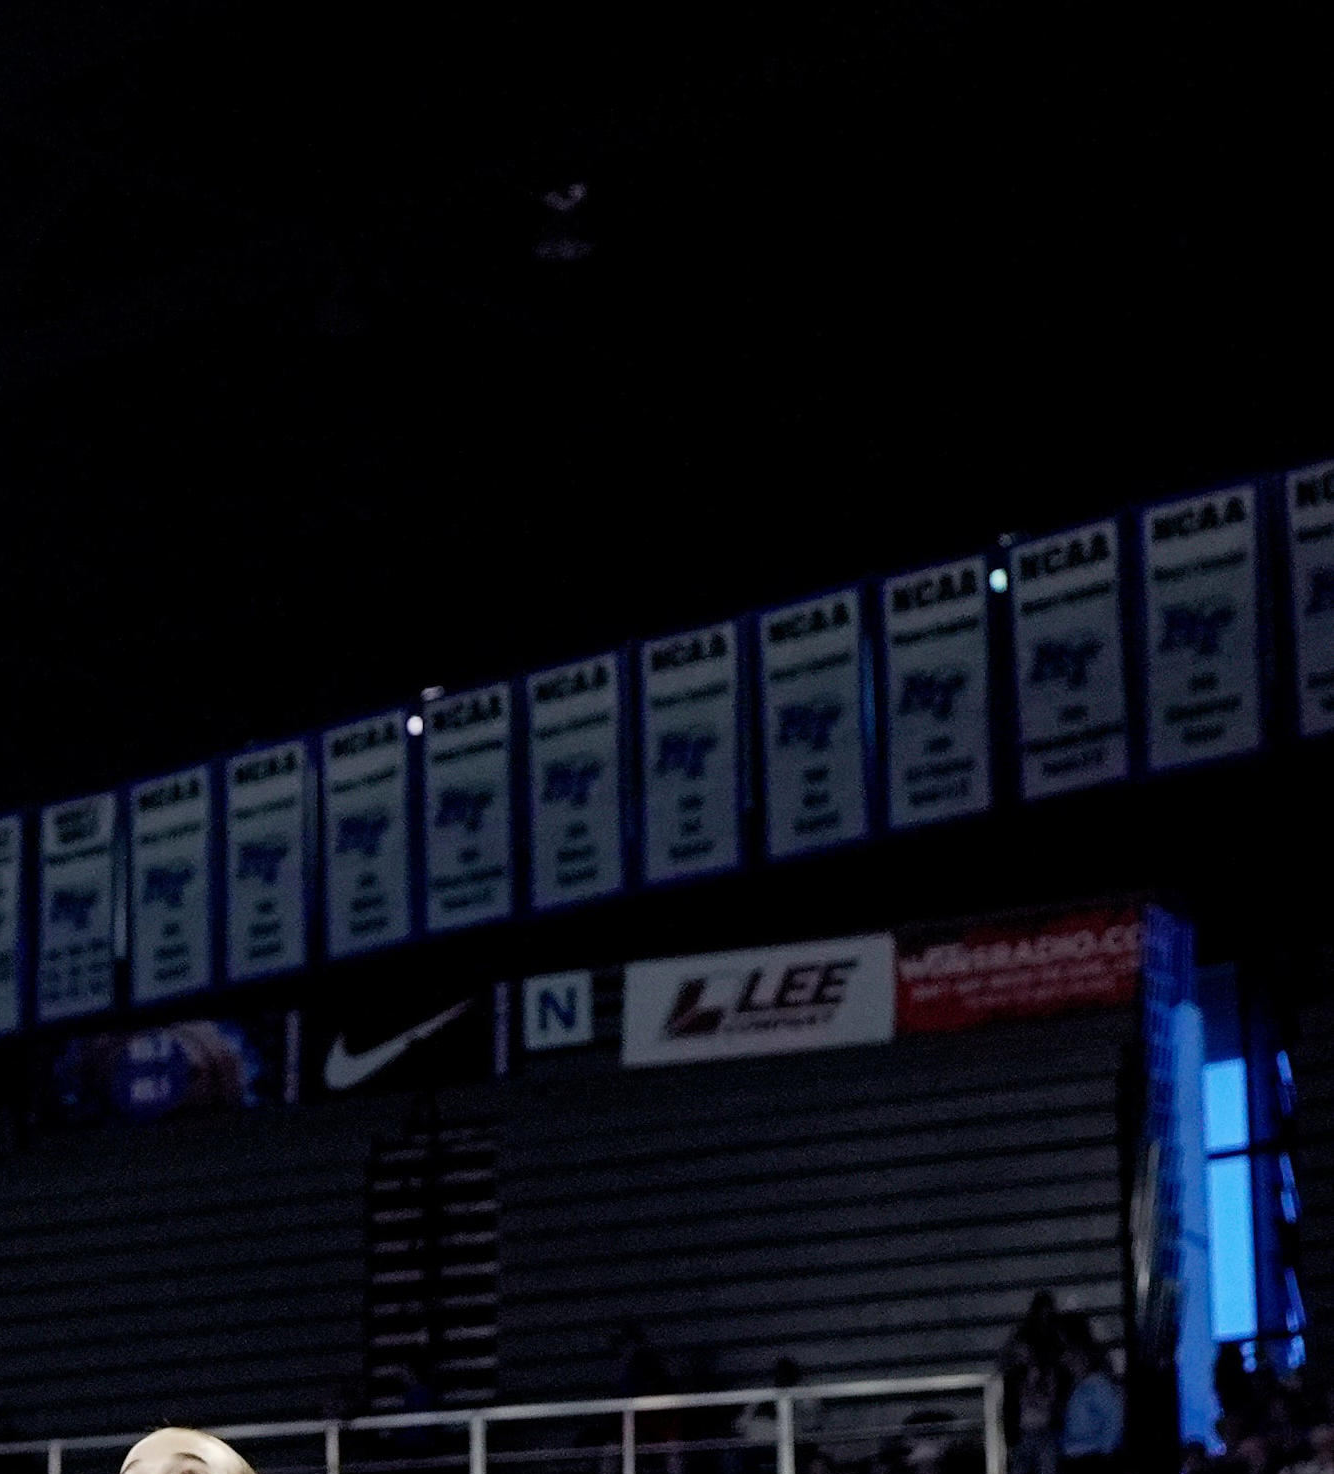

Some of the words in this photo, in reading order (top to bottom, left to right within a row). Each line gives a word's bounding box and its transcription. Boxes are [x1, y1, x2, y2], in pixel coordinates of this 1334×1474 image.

[1021, 532, 1109, 580] NCAA
[735, 957, 859, 1013] LEE
[537, 988, 579, 1031] N
